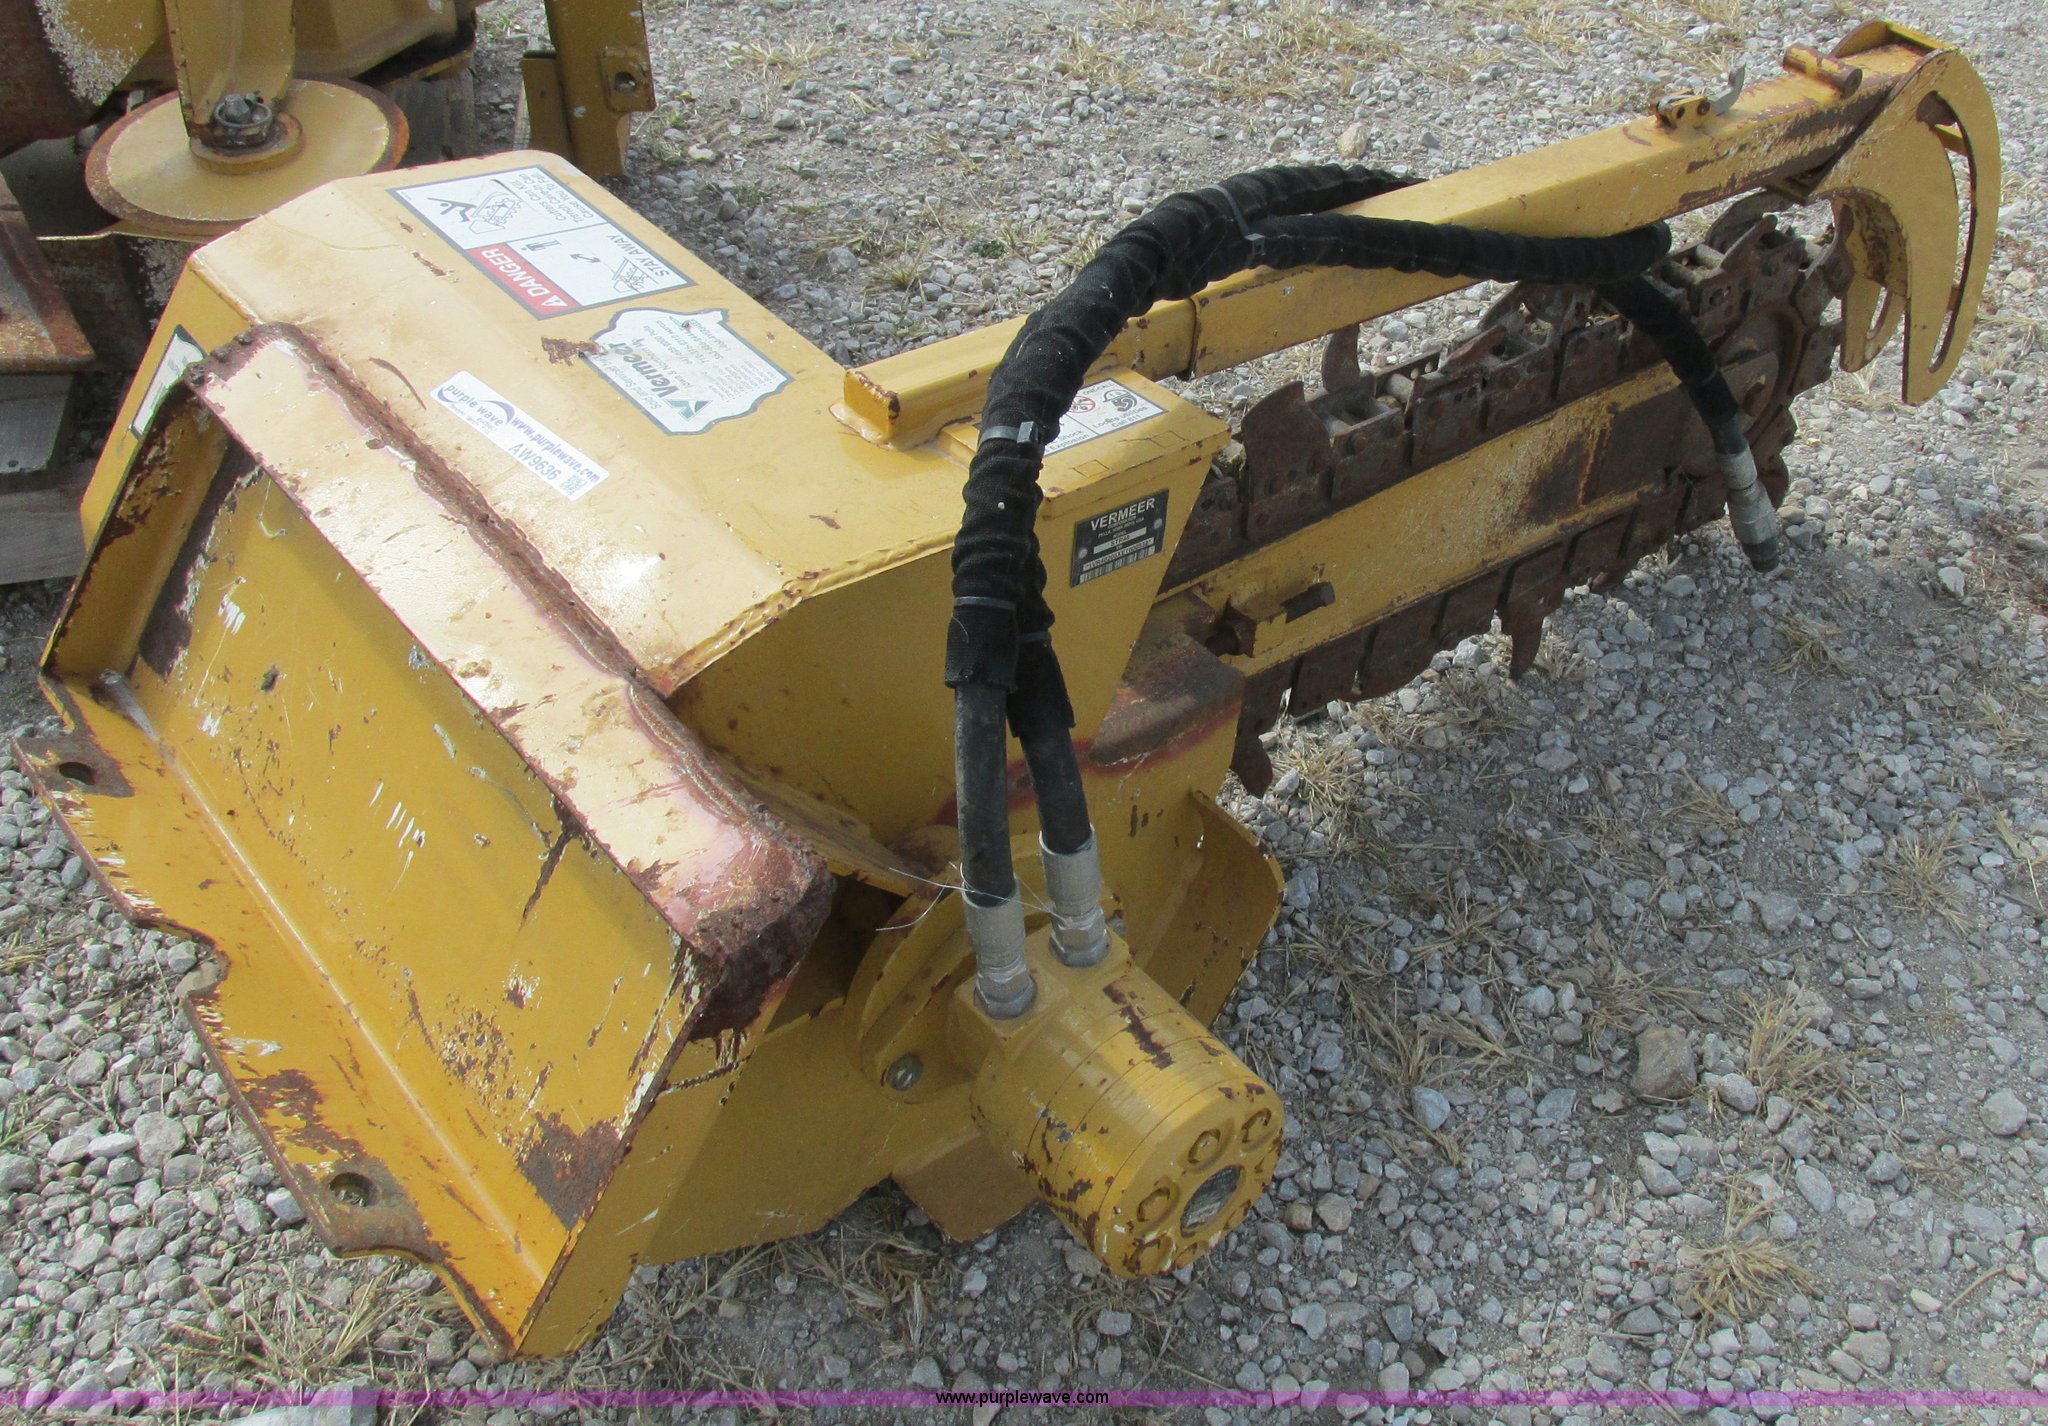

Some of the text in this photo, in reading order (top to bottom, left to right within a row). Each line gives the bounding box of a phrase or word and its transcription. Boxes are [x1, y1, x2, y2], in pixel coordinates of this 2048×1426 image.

[516, 173, 585, 222] Trench Cave-In Can
[520, 189, 543, 201] Can
[542, 182, 559, 190] To
[551, 190, 573, 201] You
[535, 201, 568, 221] Cutters
[565, 200, 595, 217] Cause
[607, 233, 670, 276] STAY AWAY
[481, 248, 549, 297] DANGER
[608, 341, 680, 398] Vermeer
[444, 384, 478, 408] purple
[476, 406, 504, 426] wave
[511, 416, 601, 483] www.purplewave.com
[1050, 434, 1089, 450] Explosion
[508, 443, 561, 480] AW9636
[1091, 498, 1155, 531] VERMEER
